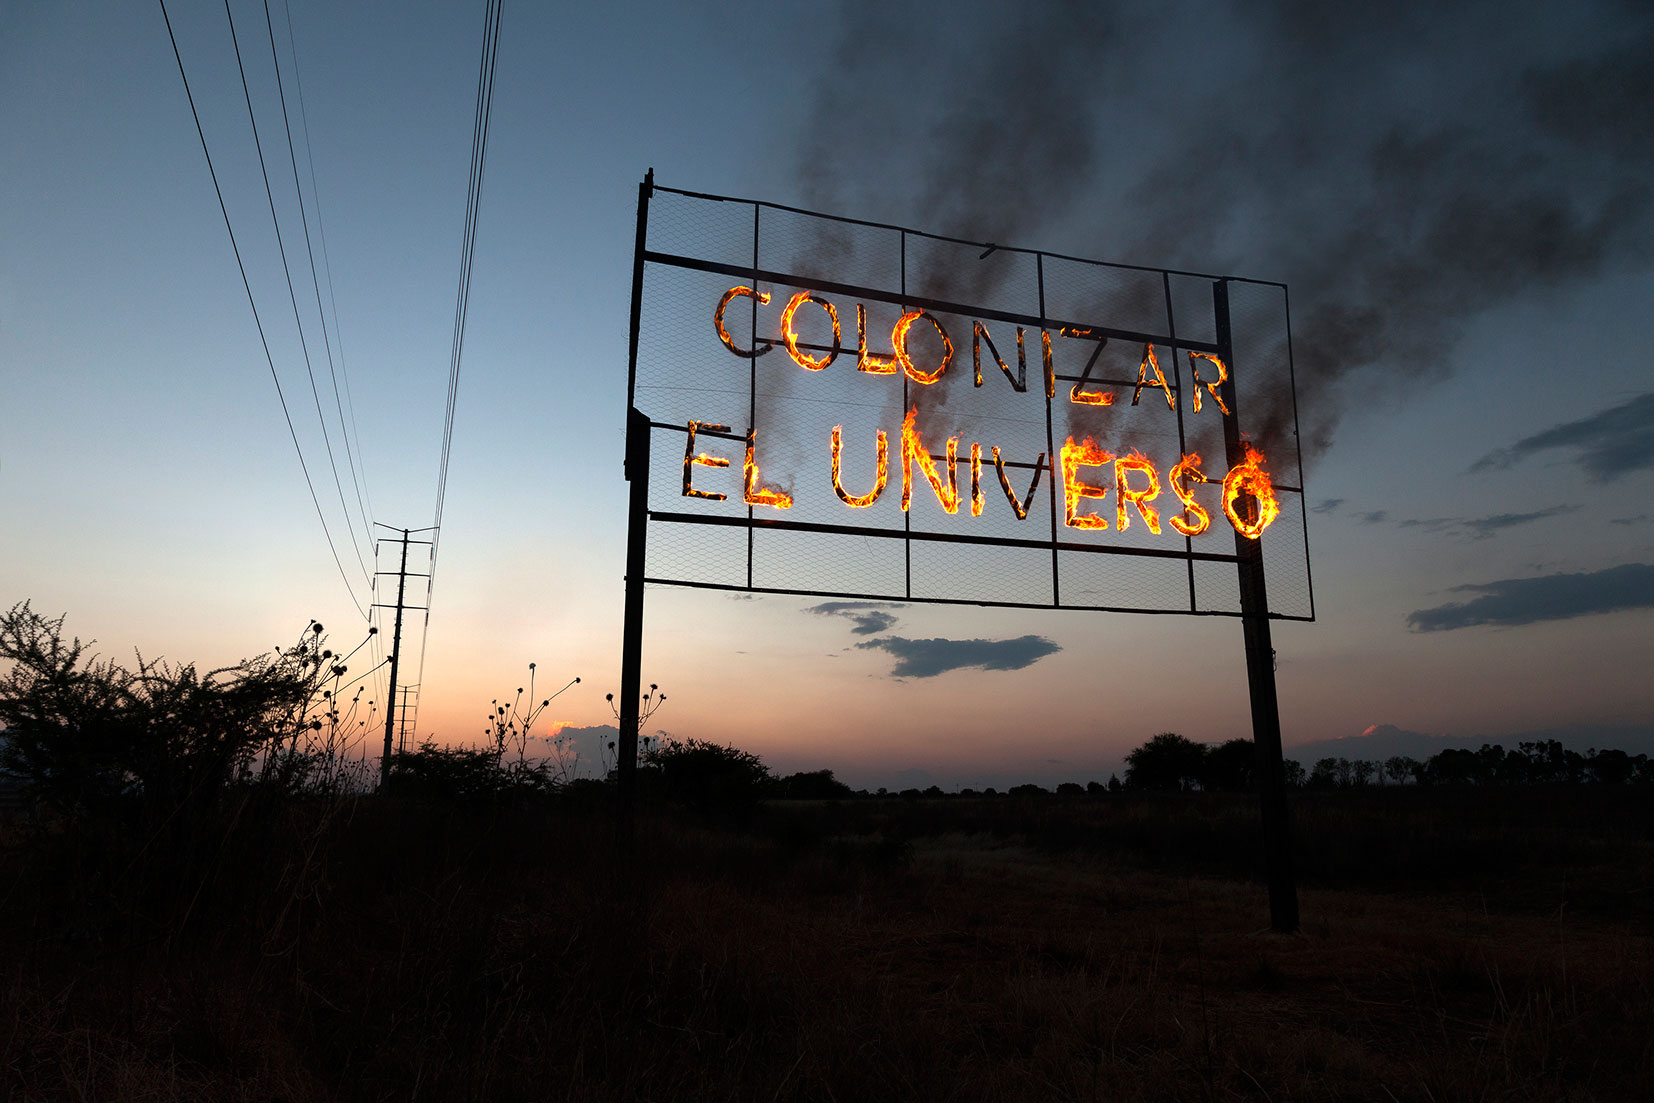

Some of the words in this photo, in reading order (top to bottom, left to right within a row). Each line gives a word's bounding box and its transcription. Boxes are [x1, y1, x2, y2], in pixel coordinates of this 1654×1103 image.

[714, 285, 1231, 416] COLONIZAR
[682, 419, 793, 510] EL
[831, 413, 1279, 540] UNIVERSO
